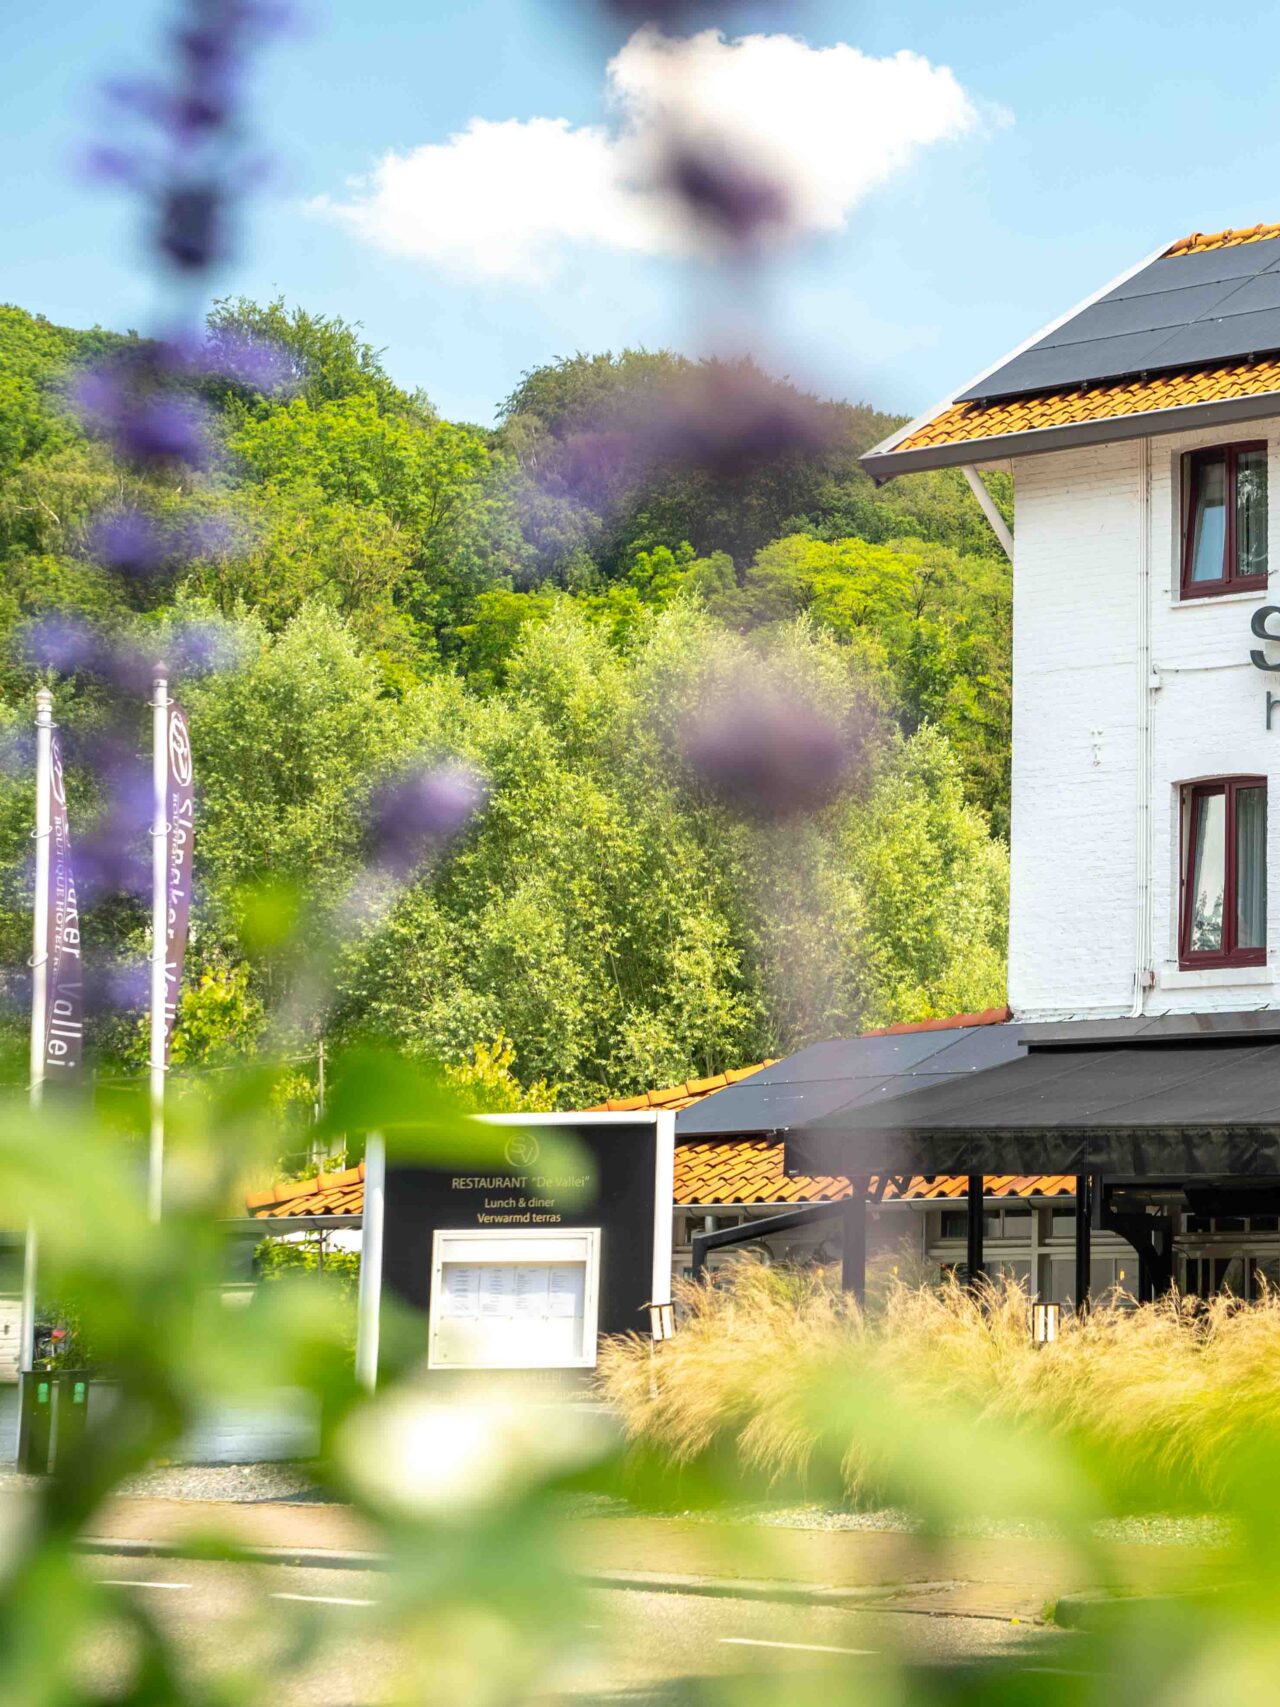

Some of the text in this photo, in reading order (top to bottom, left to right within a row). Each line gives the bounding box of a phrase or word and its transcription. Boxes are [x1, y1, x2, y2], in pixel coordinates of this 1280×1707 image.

[54, 816, 66, 897] BOUTIQUE
[55, 901, 65, 951] HOTEL
[46, 982, 83, 1067] Vallei
[451, 1177, 528, 1190] RESTAURANT
[477, 1212, 562, 1224] Verwarmd terras
[484, 1197, 555, 1209] Lunch & diner
